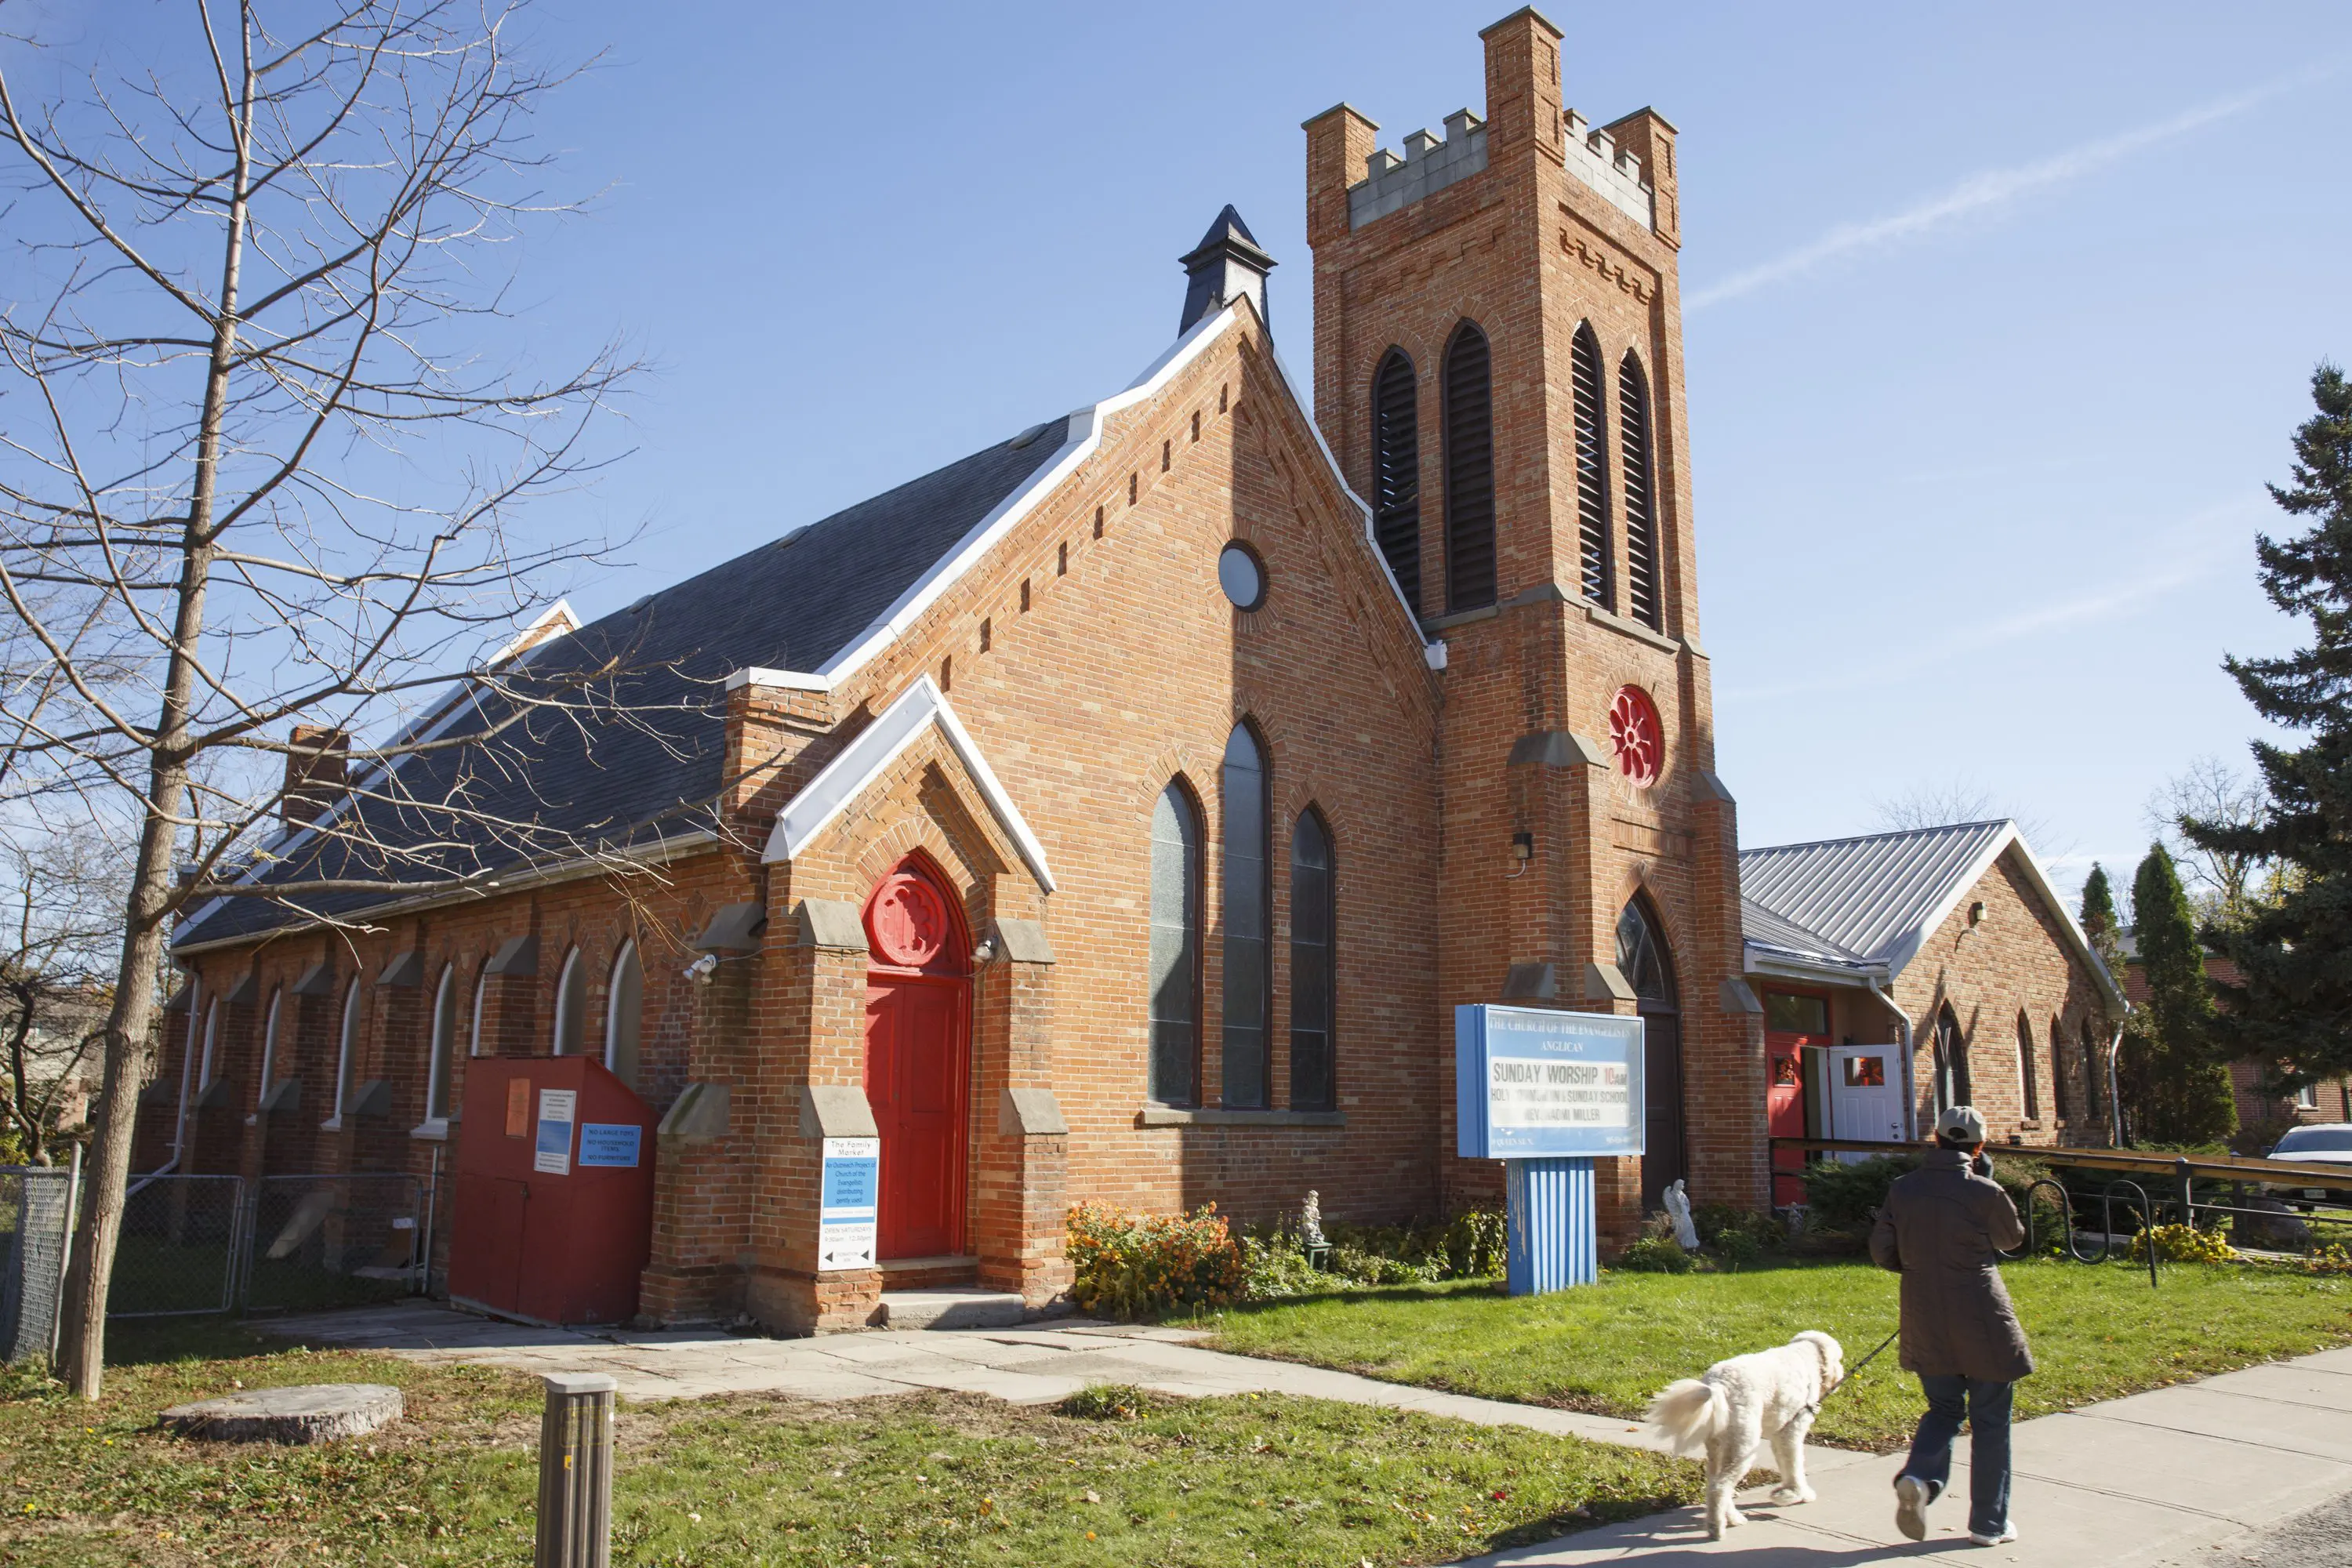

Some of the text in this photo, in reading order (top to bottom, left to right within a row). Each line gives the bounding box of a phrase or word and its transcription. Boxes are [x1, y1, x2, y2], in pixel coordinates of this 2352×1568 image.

[1489, 1017, 1631, 1038] THE CHURCH OF THE EVANGELISTS
[1541, 1040, 1584, 1052] ANGLICAN
[1494, 1062, 1541, 1083] SUNDAY
[1547, 1065, 1598, 1085] WORSHIP
[1491, 1088, 1509, 1102] HOLY
[1568, 1090, 1598, 1102] SUNDAY
[1599, 1091, 1629, 1104] SCHOOL
[1573, 1109, 1601, 1121] MILLER
[847, 1141, 871, 1149] Family
